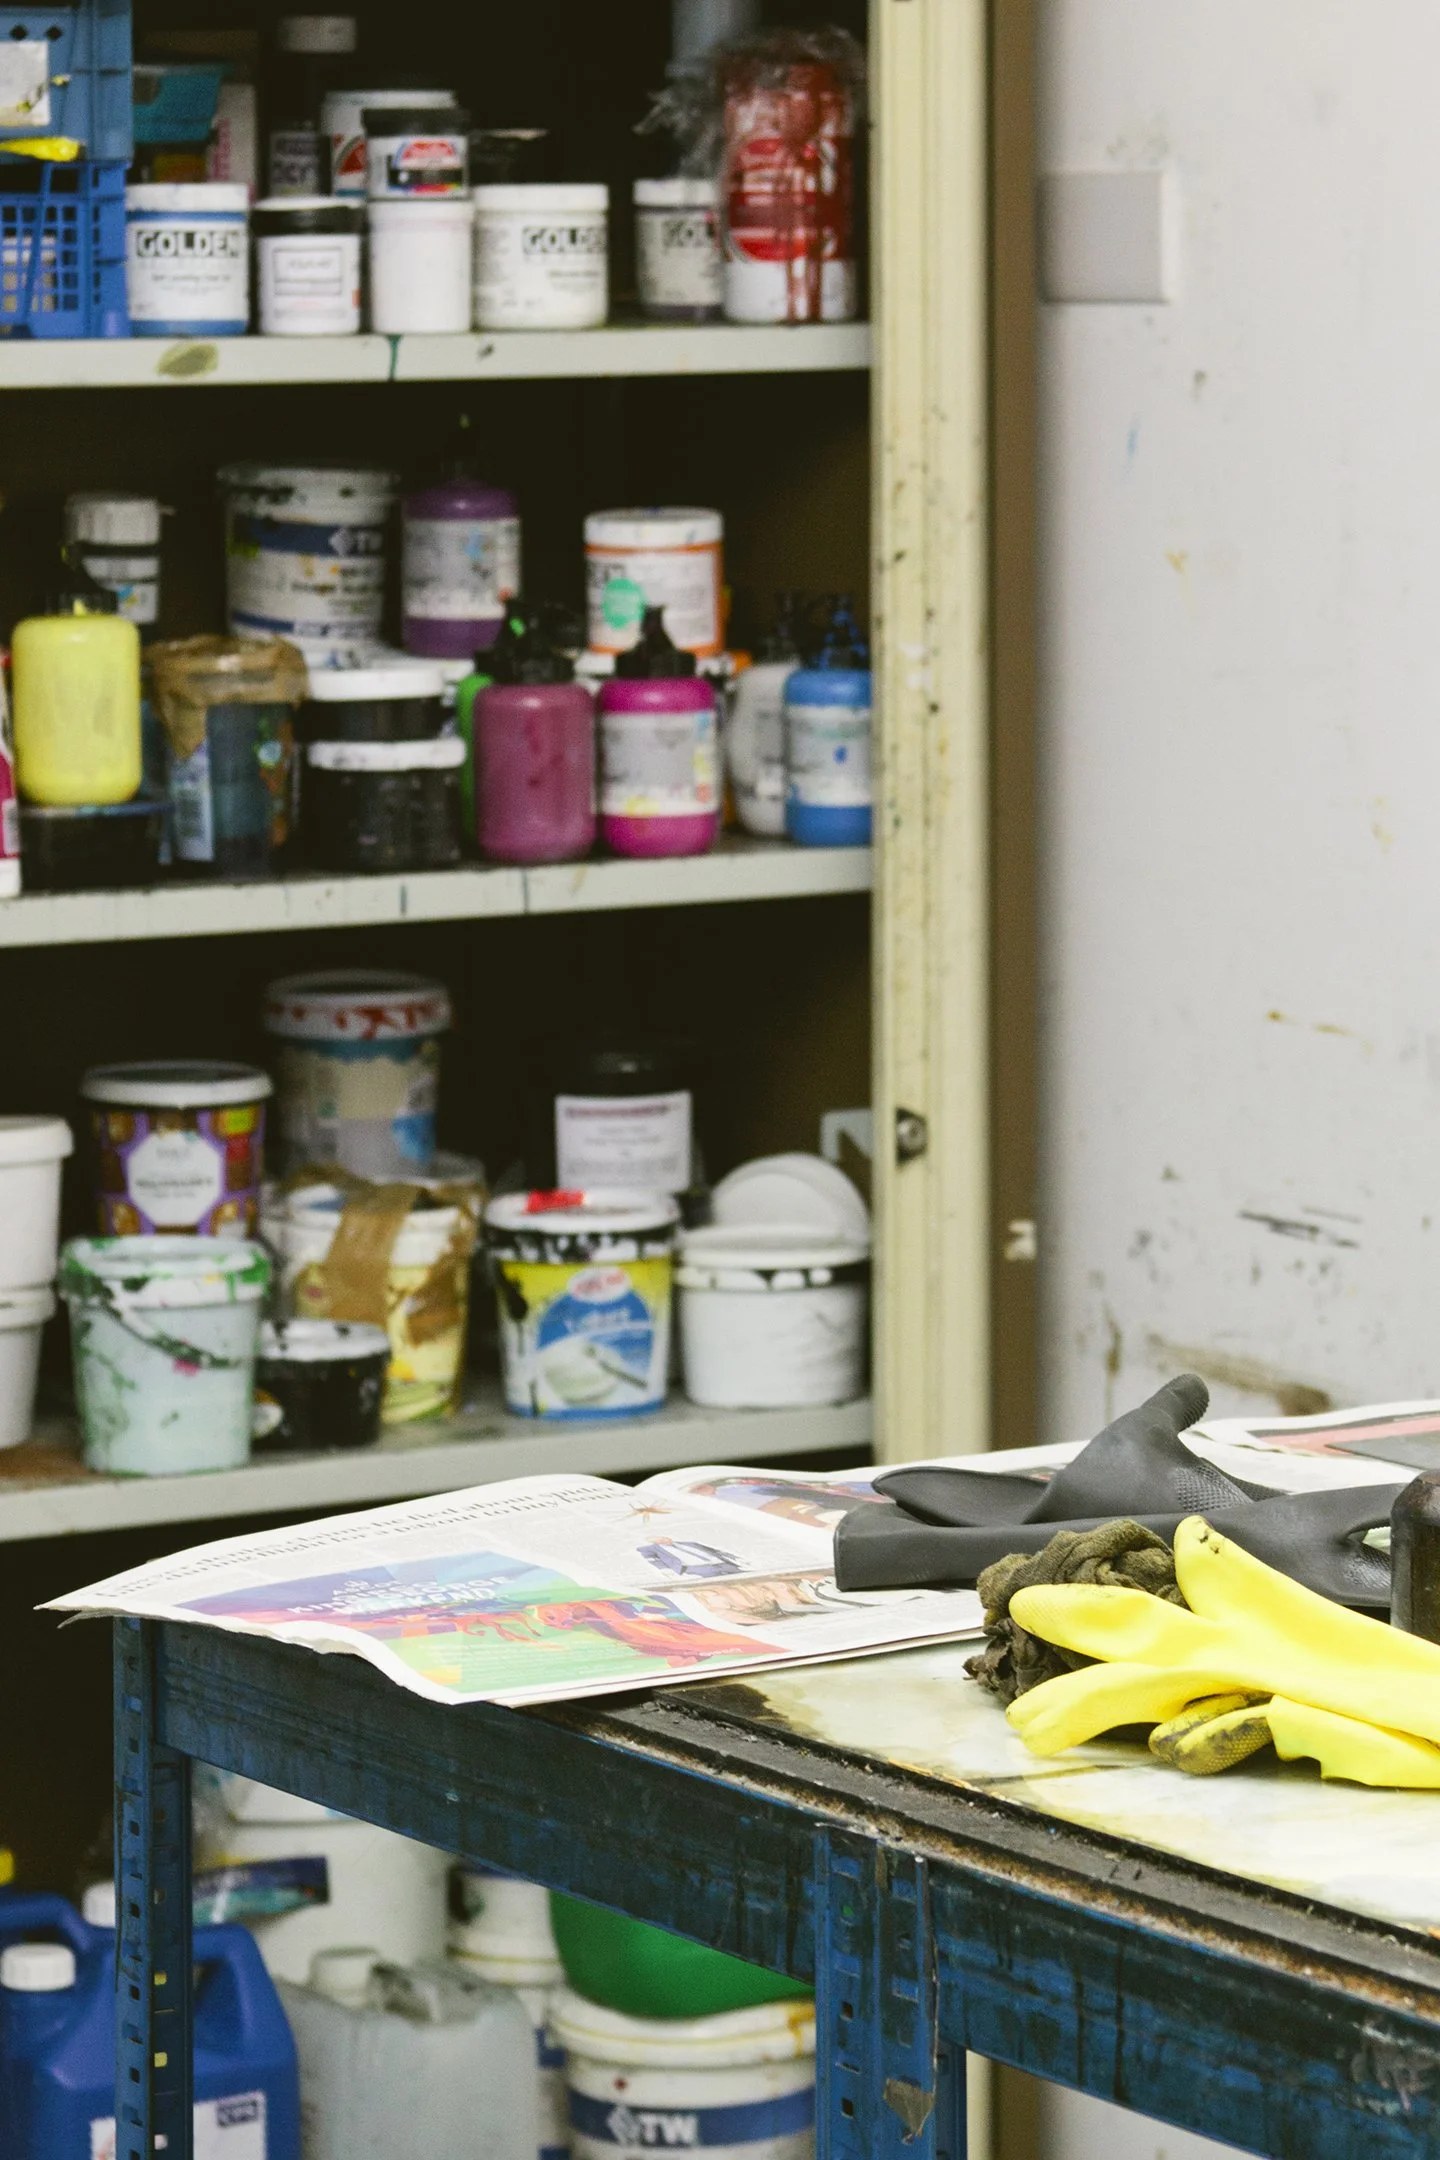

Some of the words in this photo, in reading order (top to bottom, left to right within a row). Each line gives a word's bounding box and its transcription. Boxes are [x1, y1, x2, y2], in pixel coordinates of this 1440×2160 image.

[137, 229, 240, 258] GOLDEN
[371, 1518, 405, 1528] he
[407, 1507, 458, 1521] lied
[461, 1495, 533, 1512] about
[539, 1486, 614, 1499] spider
[393, 1514, 479, 1534] payout
[482, 1508, 511, 1517] to
[509, 1500, 559, 1512] buy
[560, 1491, 638, 1504] house
[638, 2113, 697, 2144] TW
